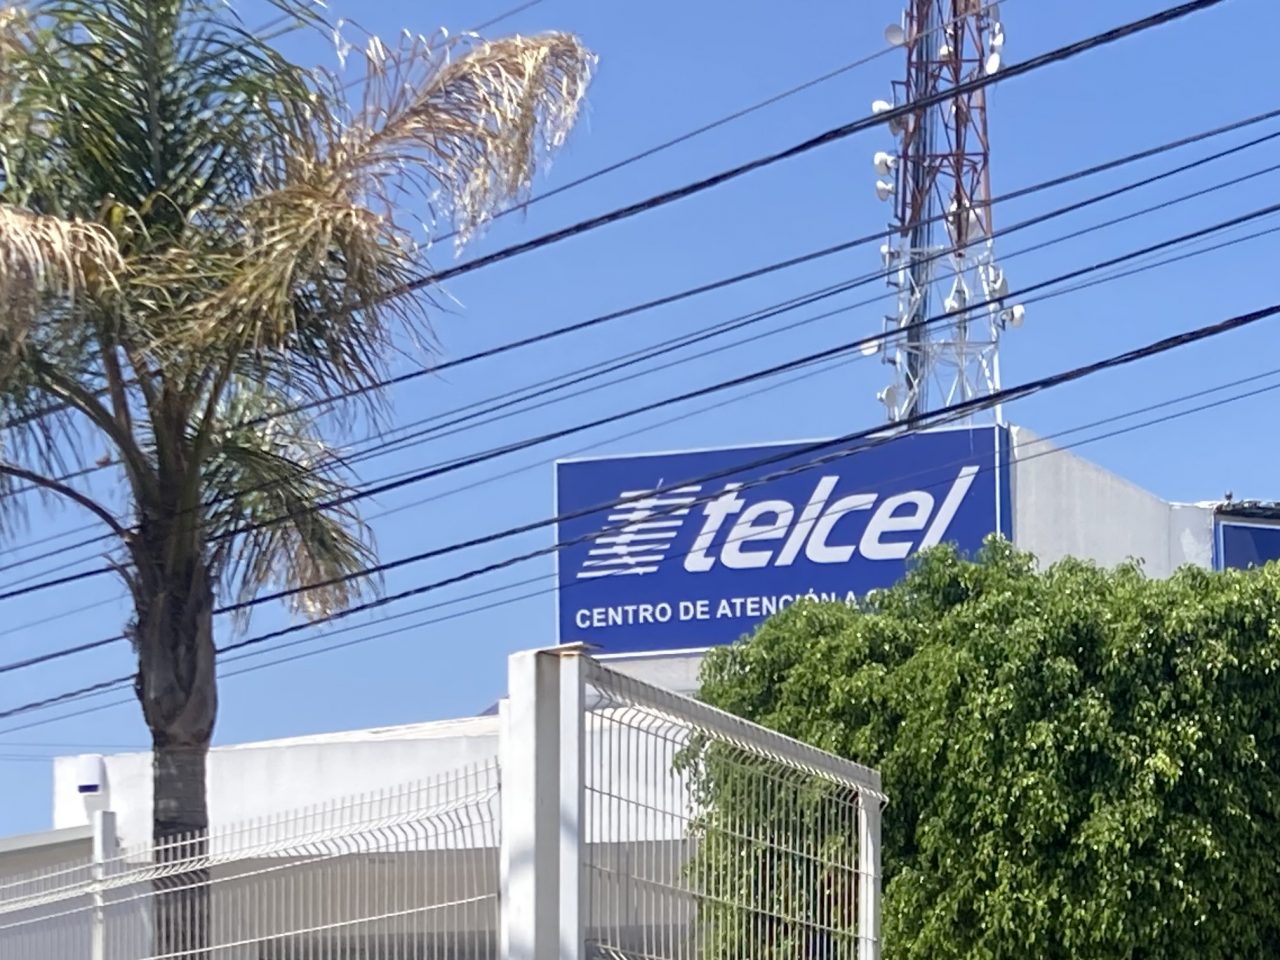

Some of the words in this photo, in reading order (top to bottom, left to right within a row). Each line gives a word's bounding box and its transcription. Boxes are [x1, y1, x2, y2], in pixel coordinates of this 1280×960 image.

[683, 465, 980, 573] telcel
[575, 602, 672, 628] CENTRO
[679, 600, 710, 621] DE
